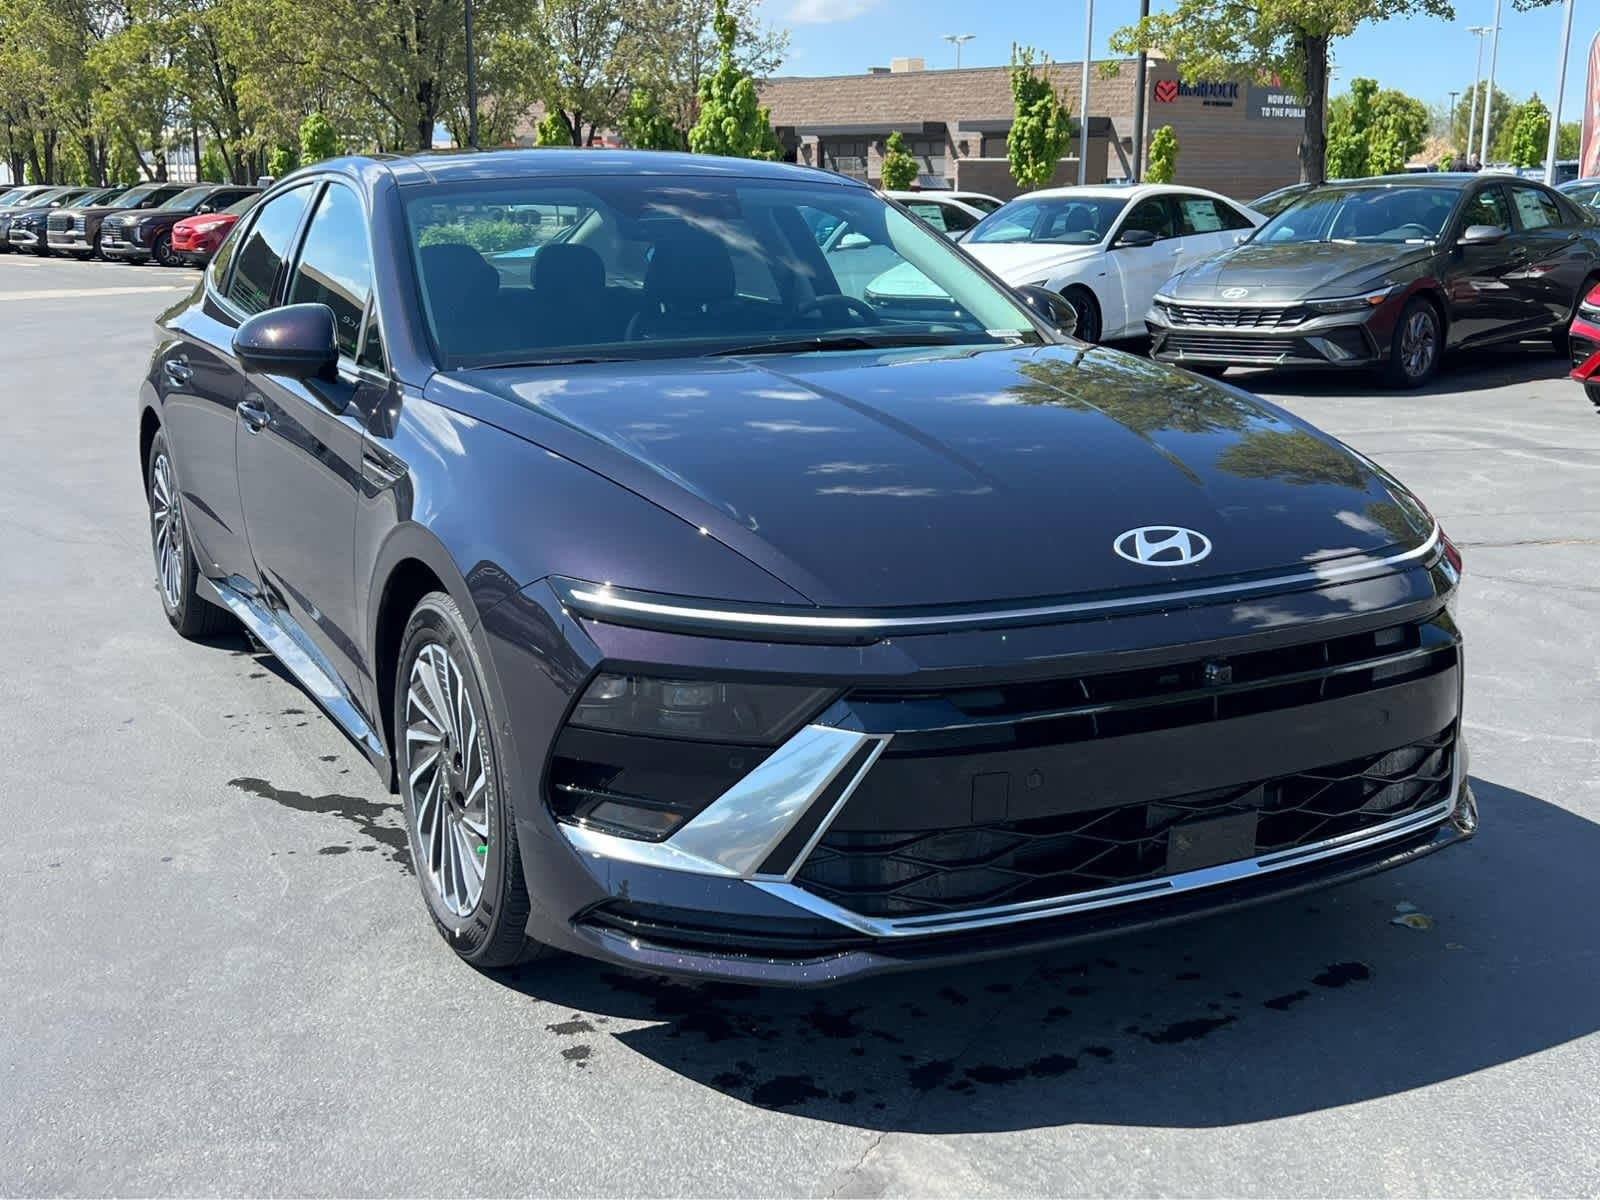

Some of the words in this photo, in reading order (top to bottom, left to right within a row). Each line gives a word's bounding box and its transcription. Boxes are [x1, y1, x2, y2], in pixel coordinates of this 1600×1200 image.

[1267, 94, 1284, 105] NOW
[1261, 107, 1271, 117] TO
[1271, 107, 1284, 117] THE
[1284, 107, 1306, 118] PUBLI
